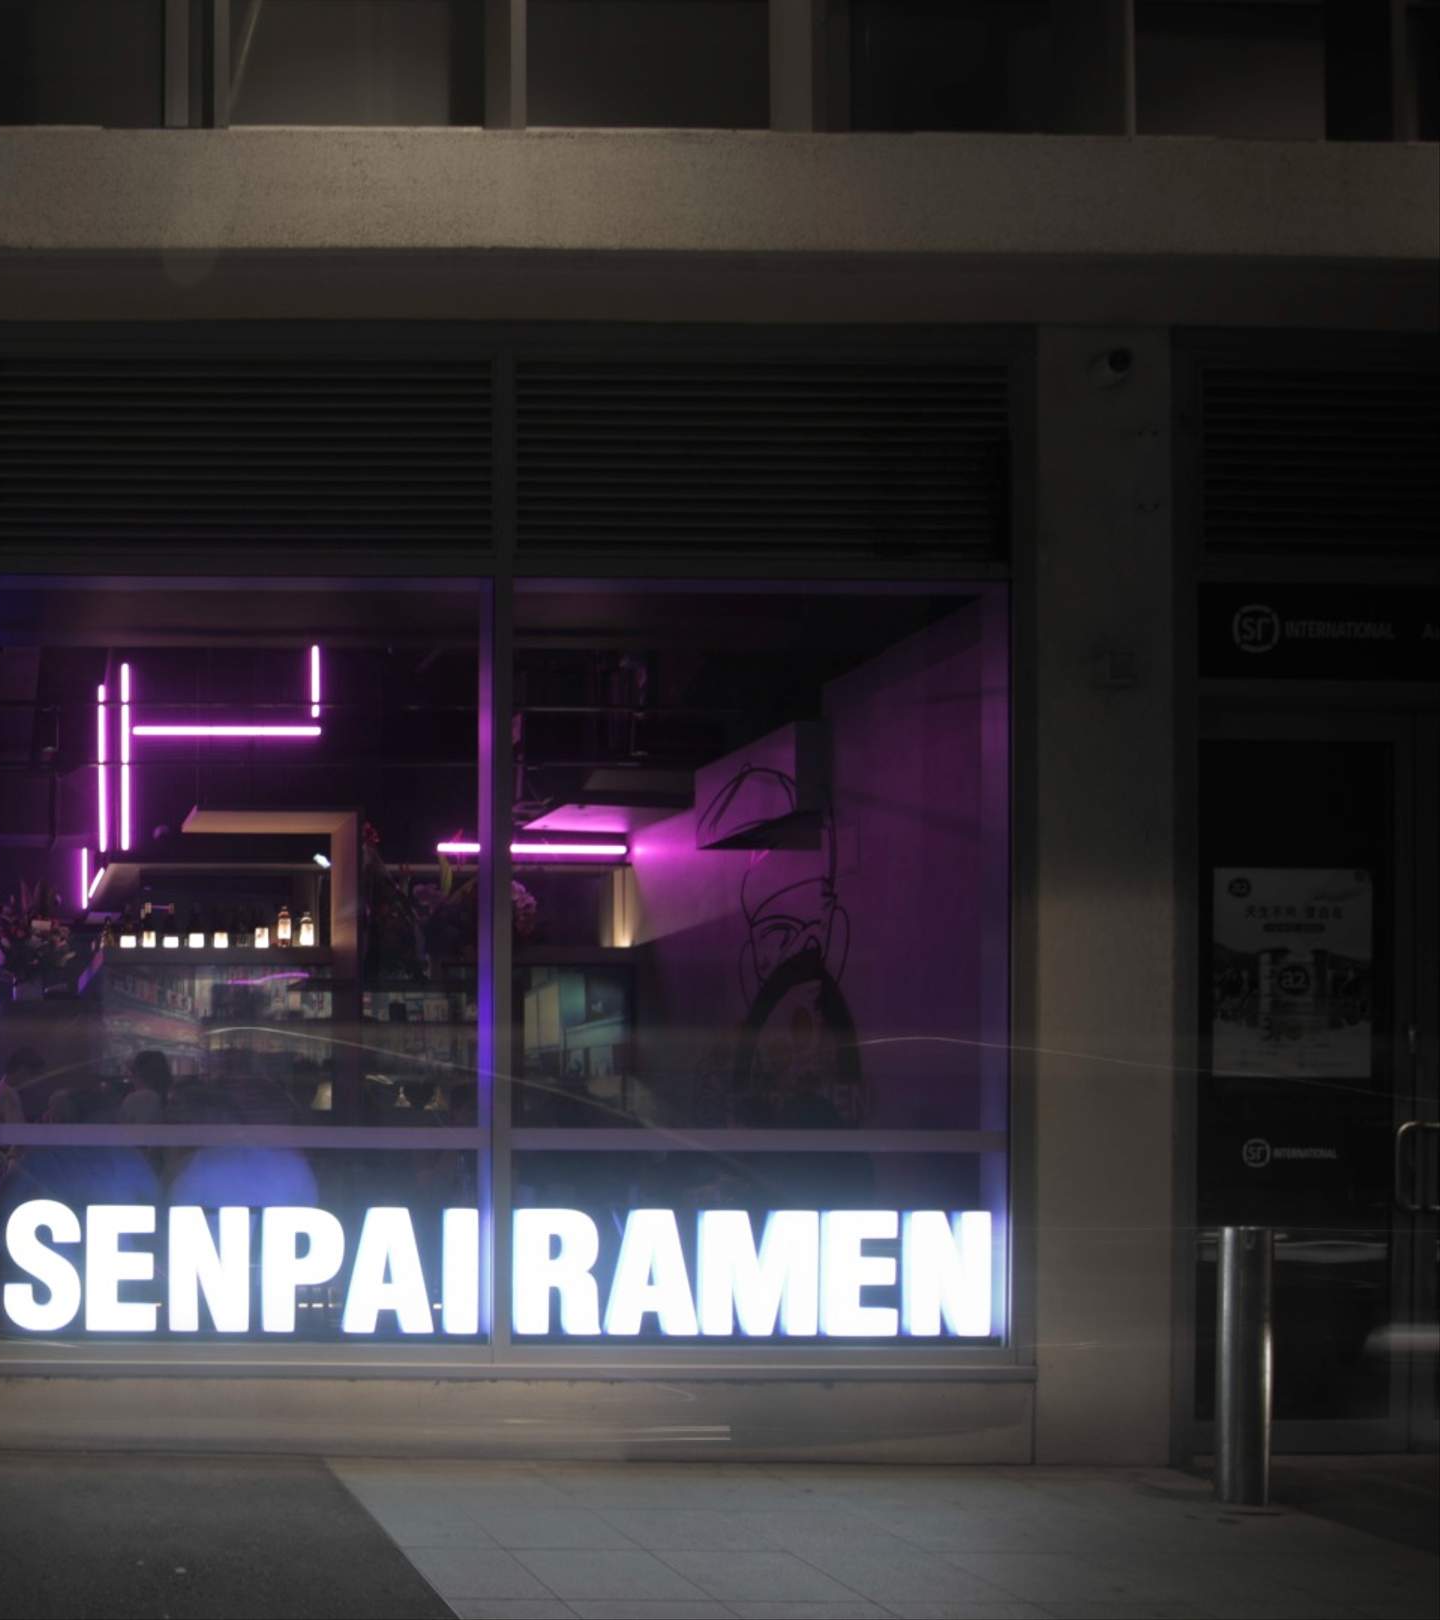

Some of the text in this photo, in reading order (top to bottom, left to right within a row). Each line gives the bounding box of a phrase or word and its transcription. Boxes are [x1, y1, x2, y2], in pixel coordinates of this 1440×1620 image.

[1284, 620, 1396, 639] INTERNATIONAL
[4, 1199, 992, 1336] SENPAI RAMEN
